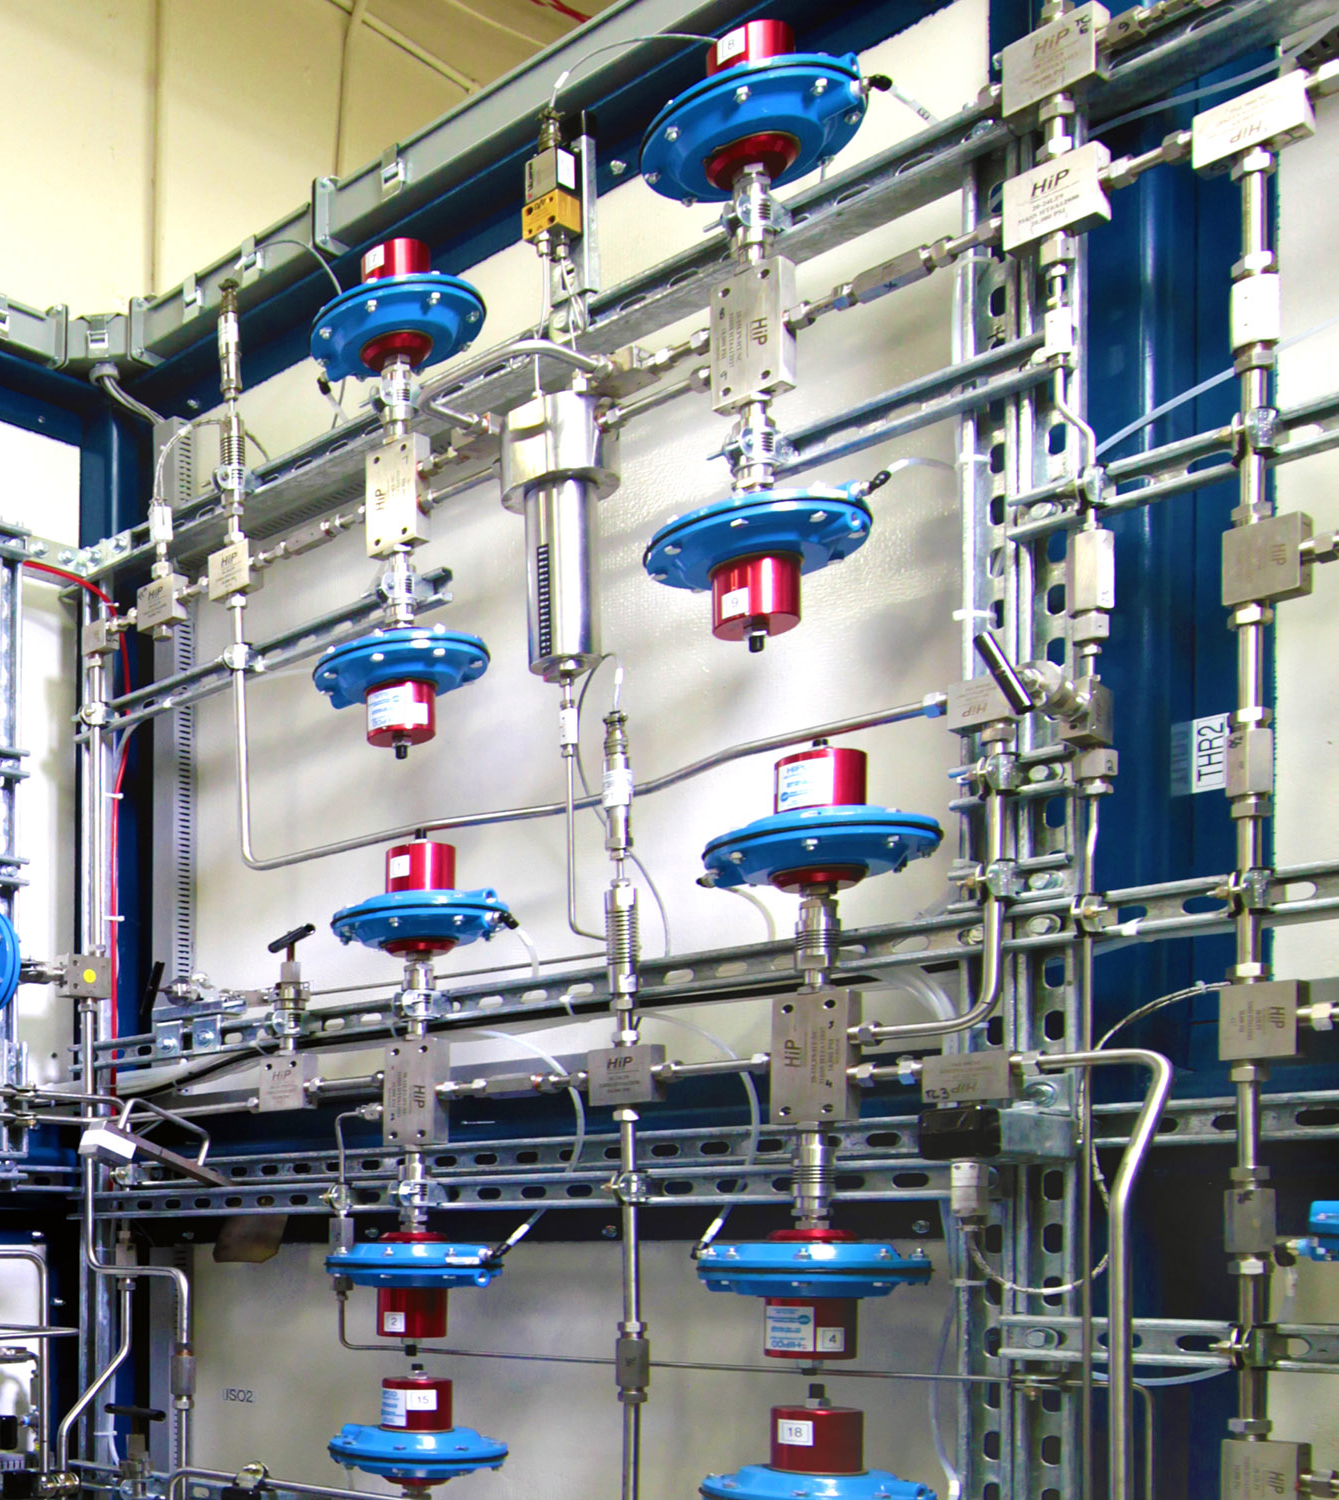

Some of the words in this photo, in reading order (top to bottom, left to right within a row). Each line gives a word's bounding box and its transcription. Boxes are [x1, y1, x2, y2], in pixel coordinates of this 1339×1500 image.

[1032, 27, 1070, 58] HiP
[1229, 121, 1261, 145] HiP
[1031, 168, 1071, 198] HiP
[751, 316, 768, 346] HiP
[374, 488, 387, 511] HiP
[962, 702, 988, 718] HiP
[1197, 722, 1225, 783] THR2
[1270, 1006, 1286, 1030] HiP
[607, 1055, 633, 1070] HiP
[784, 1039, 803, 1068] HiP
[272, 1069, 292, 1081] HiP
[413, 1085, 426, 1109] HiP
[390, 1317, 398, 1327] 2
[828, 1334, 837, 1344] 4
[225, 1388, 254, 1404] ISO2
[417, 1395, 430, 1406] 15
[787, 1426, 803, 1439] 18
[1269, 1471, 1284, 1495] HiP
